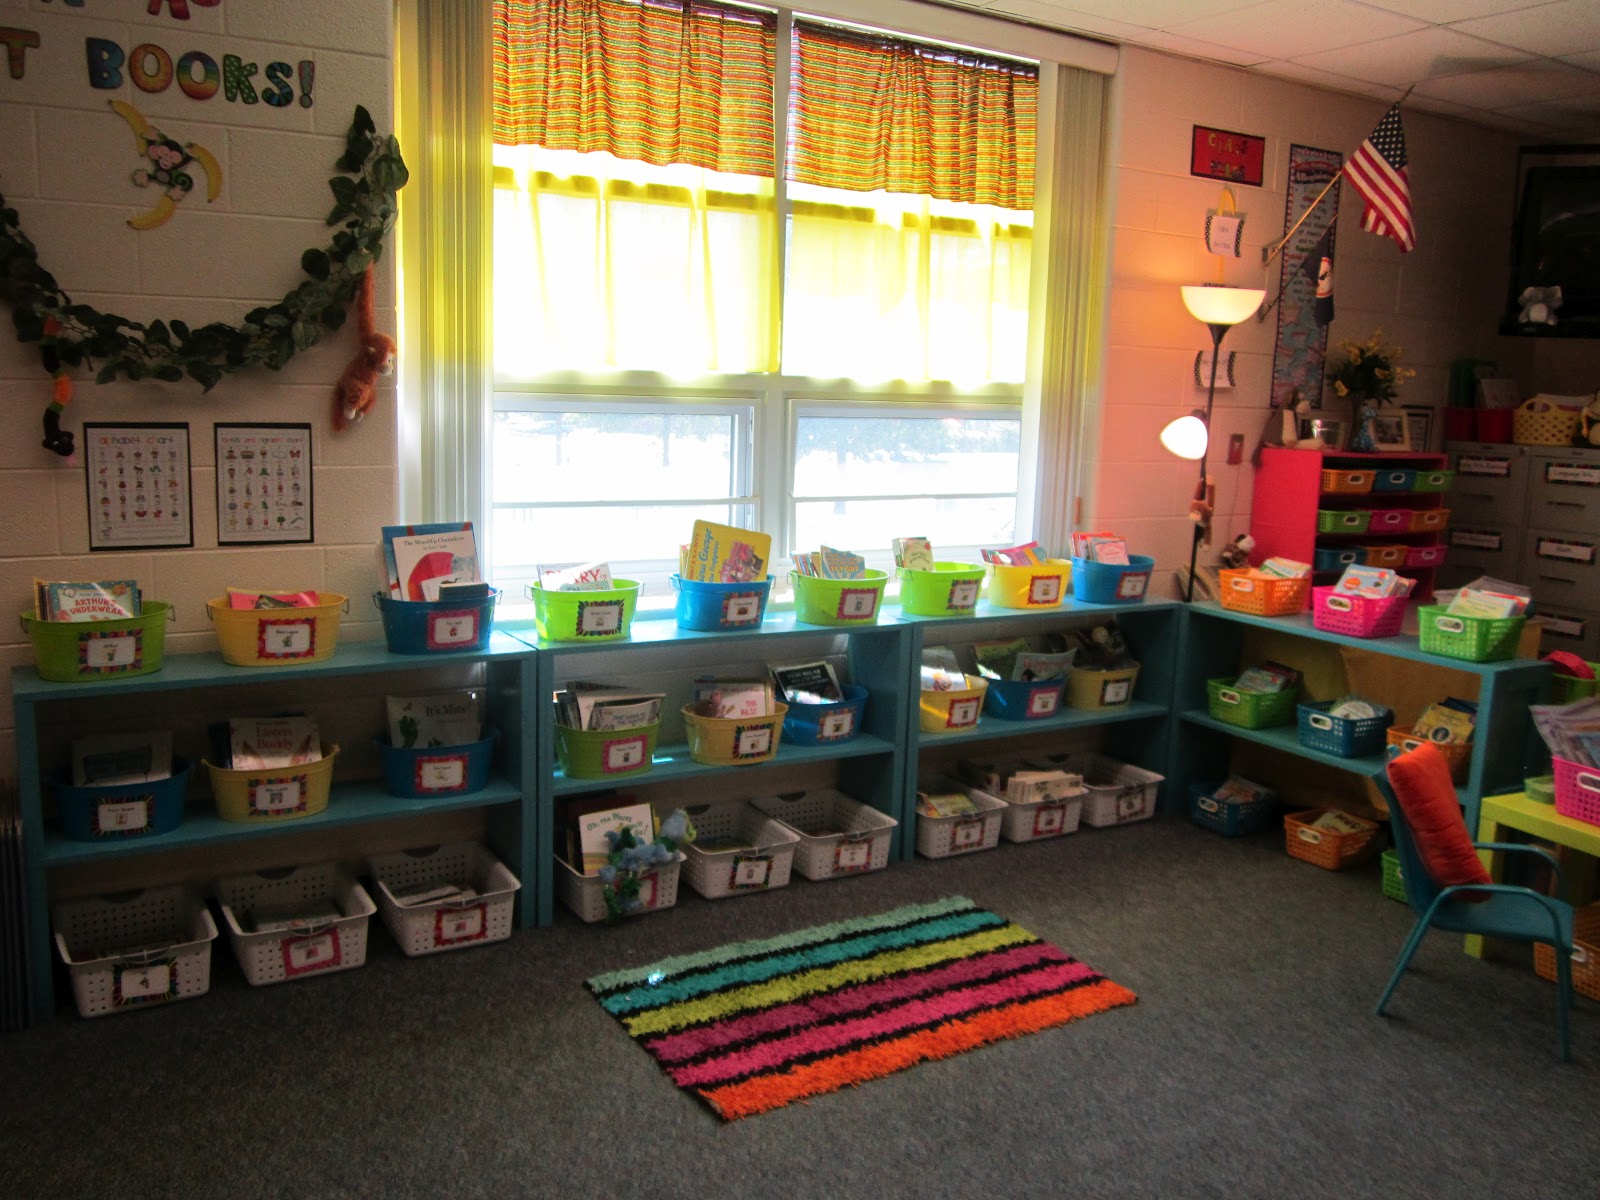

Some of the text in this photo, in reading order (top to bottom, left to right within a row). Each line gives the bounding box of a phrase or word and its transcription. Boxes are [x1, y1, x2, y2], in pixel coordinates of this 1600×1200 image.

[85, 36, 315, 109] BOOKS!
[698, 528, 714, 562] George
[75, 597, 117, 606] ARTHURS
[70, 605, 124, 616] UNDERWEAR
[740, 708, 757, 716] BEST
[587, 812, 632, 831] Oh, the Places
